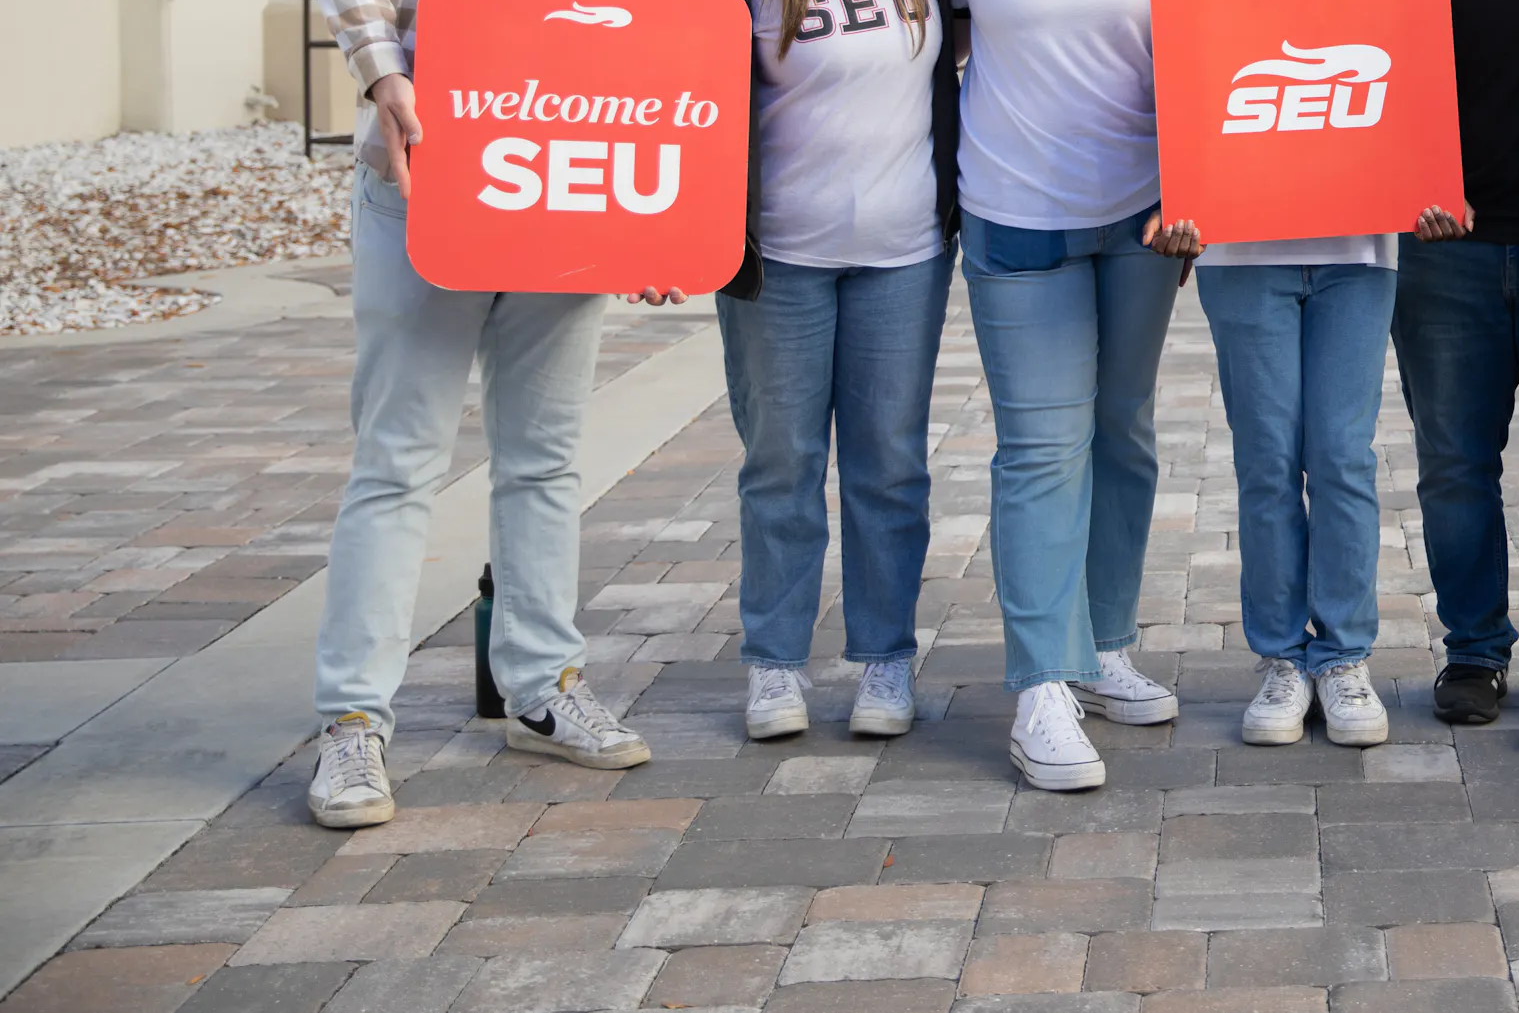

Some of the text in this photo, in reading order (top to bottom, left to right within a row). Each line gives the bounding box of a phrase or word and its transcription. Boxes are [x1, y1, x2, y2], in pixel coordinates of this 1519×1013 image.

[449, 79, 719, 128] welcome to
[1222, 82, 1389, 134] SEU
[477, 137, 682, 215] SEU
